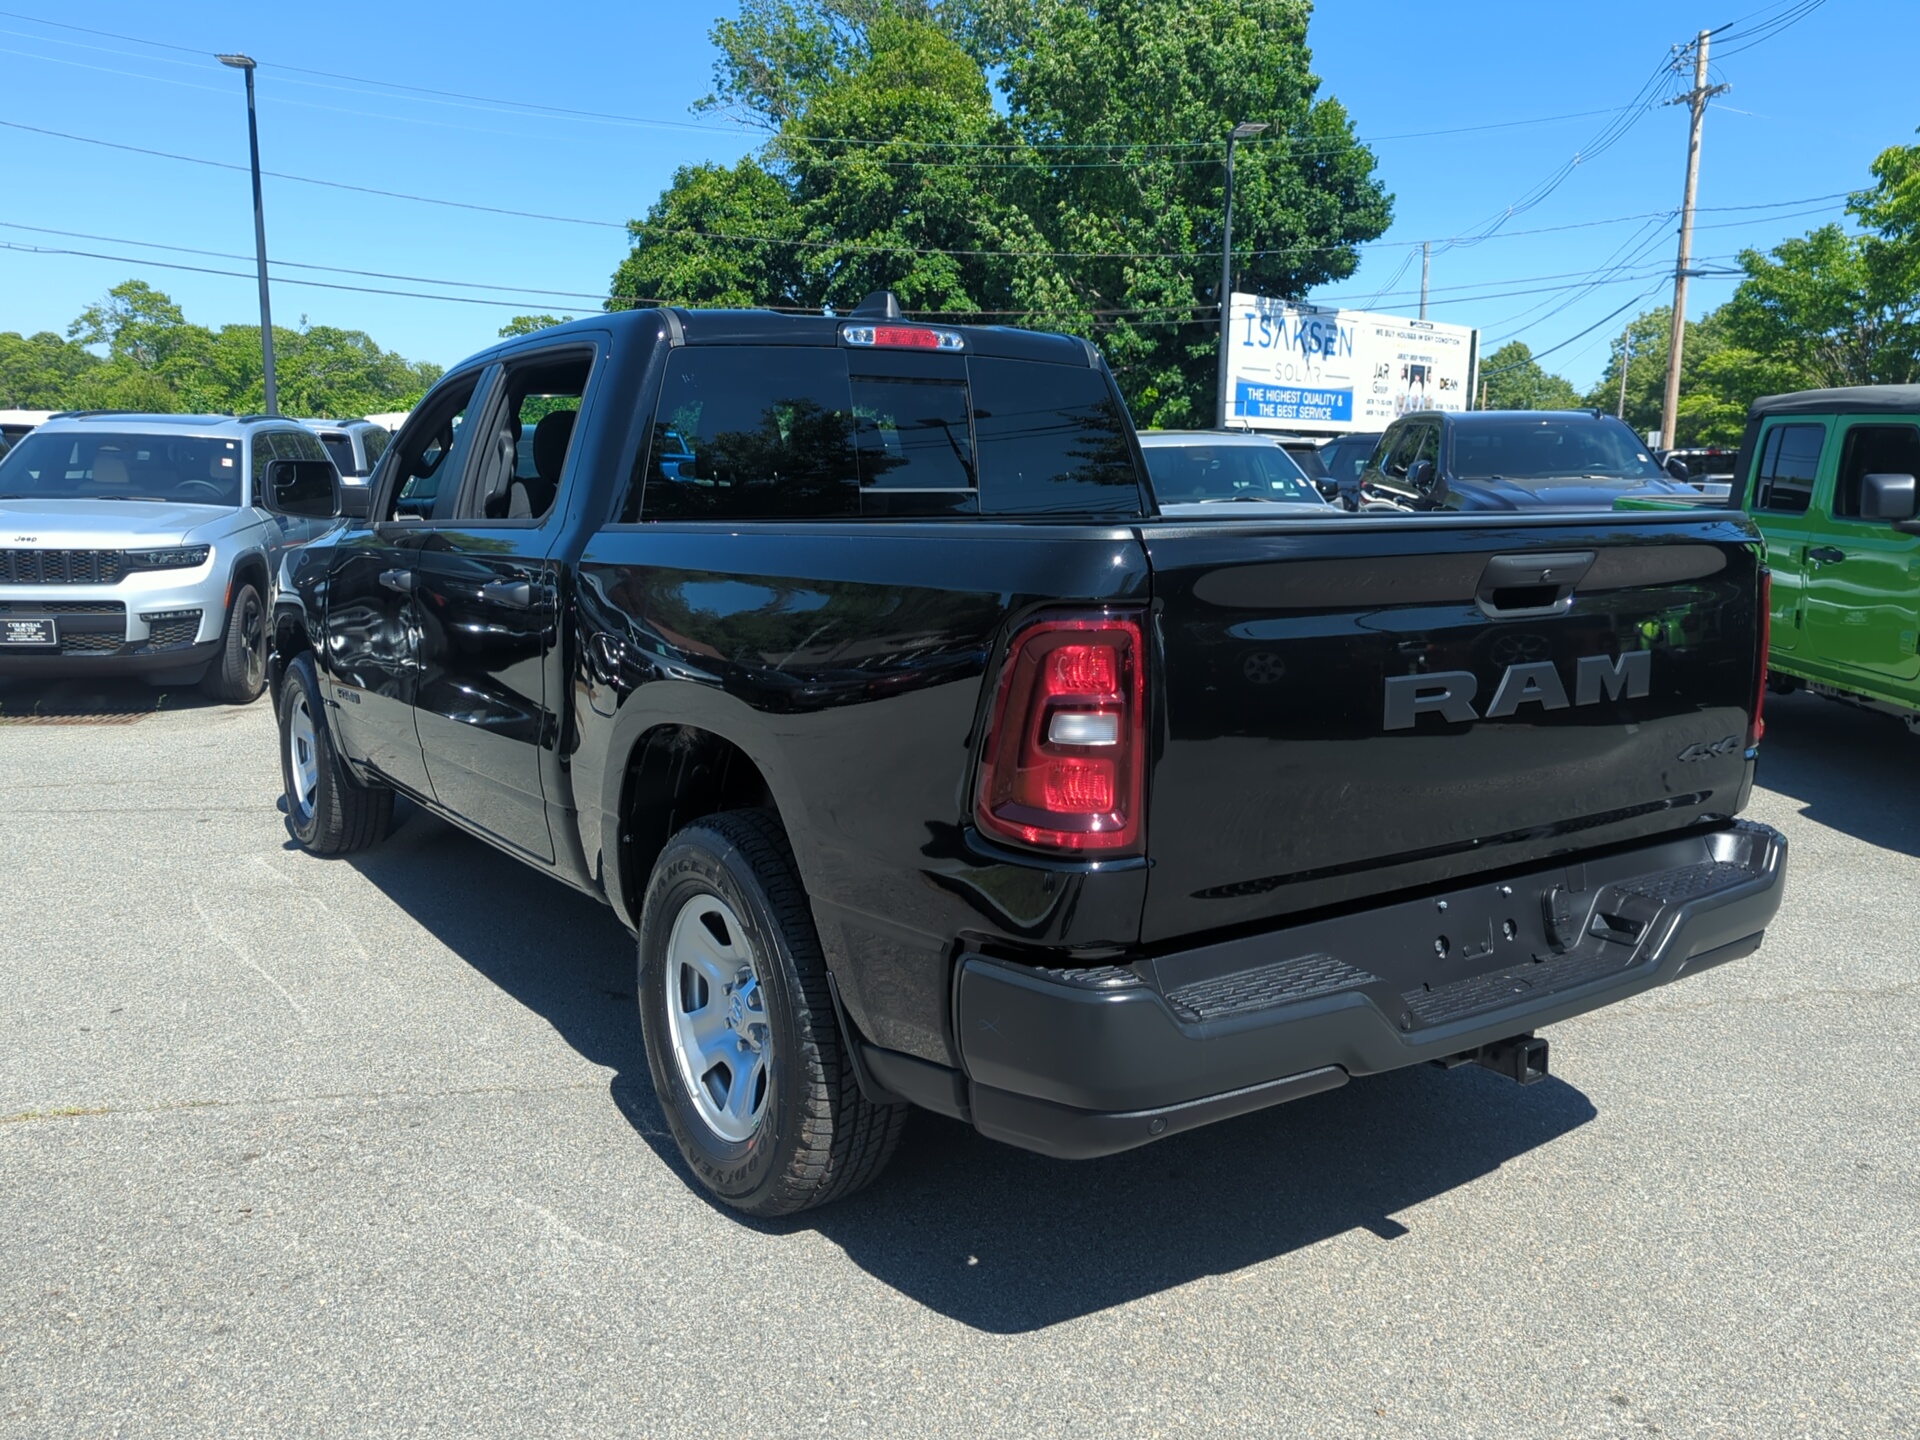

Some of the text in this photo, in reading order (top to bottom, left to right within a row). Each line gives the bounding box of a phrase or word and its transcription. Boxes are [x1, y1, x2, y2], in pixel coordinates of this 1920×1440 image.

[1243, 312, 1354, 358] ISAKSEN
[1275, 361, 1321, 383] SOLAR
[1373, 362, 1390, 380] JAR
[1439, 378, 1459, 391] DEAN
[1247, 388, 1344, 407] THE HIGHEST QUALITY &
[1258, 404, 1332, 420] THE BEST SERVICE
[1383, 650, 1652, 732] RAM
